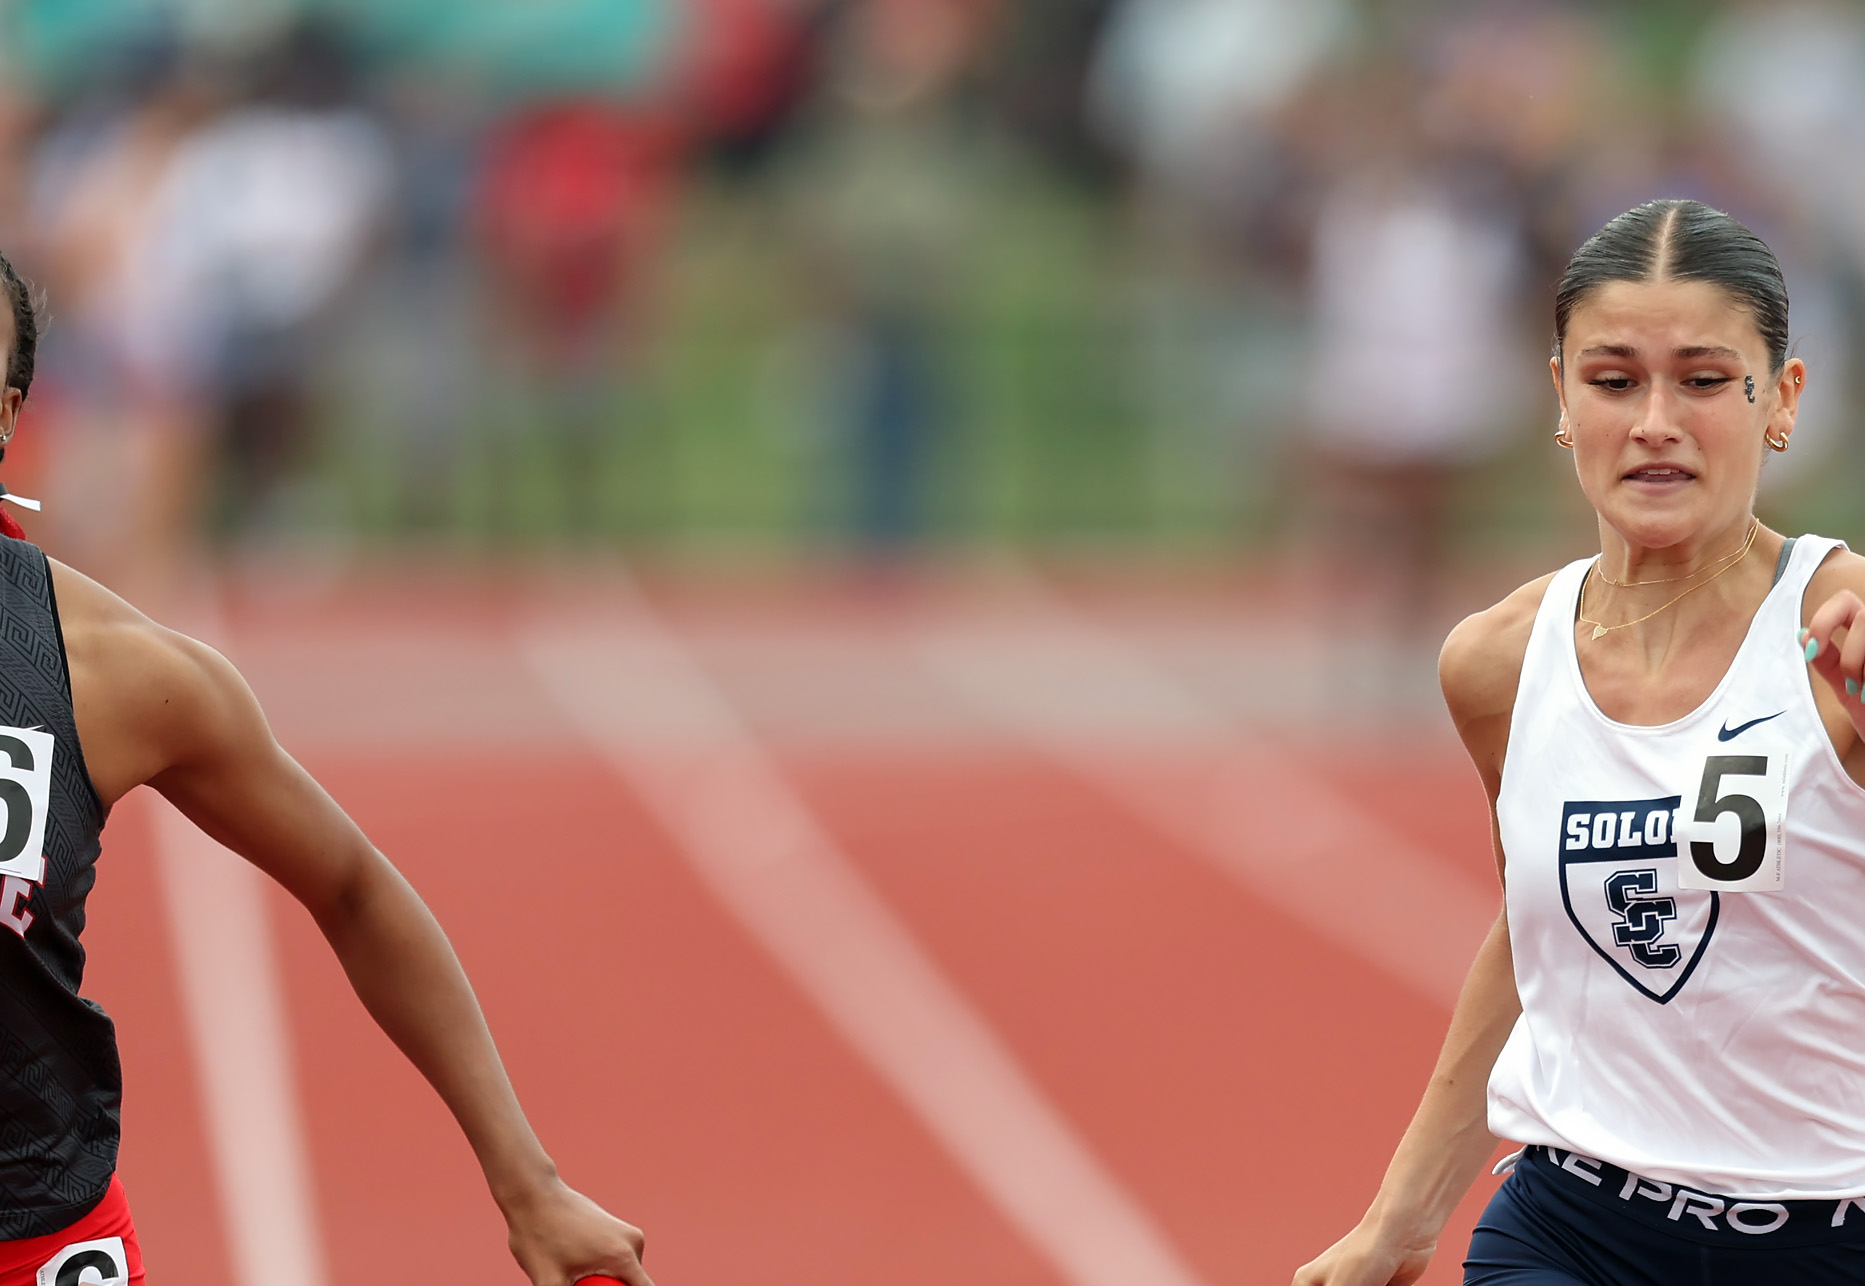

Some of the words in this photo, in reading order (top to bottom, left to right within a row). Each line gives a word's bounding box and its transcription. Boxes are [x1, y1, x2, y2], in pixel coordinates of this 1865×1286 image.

[1565, 808, 1677, 851] SOLO
[1689, 755, 1768, 881] 5
[1618, 1171, 1790, 1235] PRO
